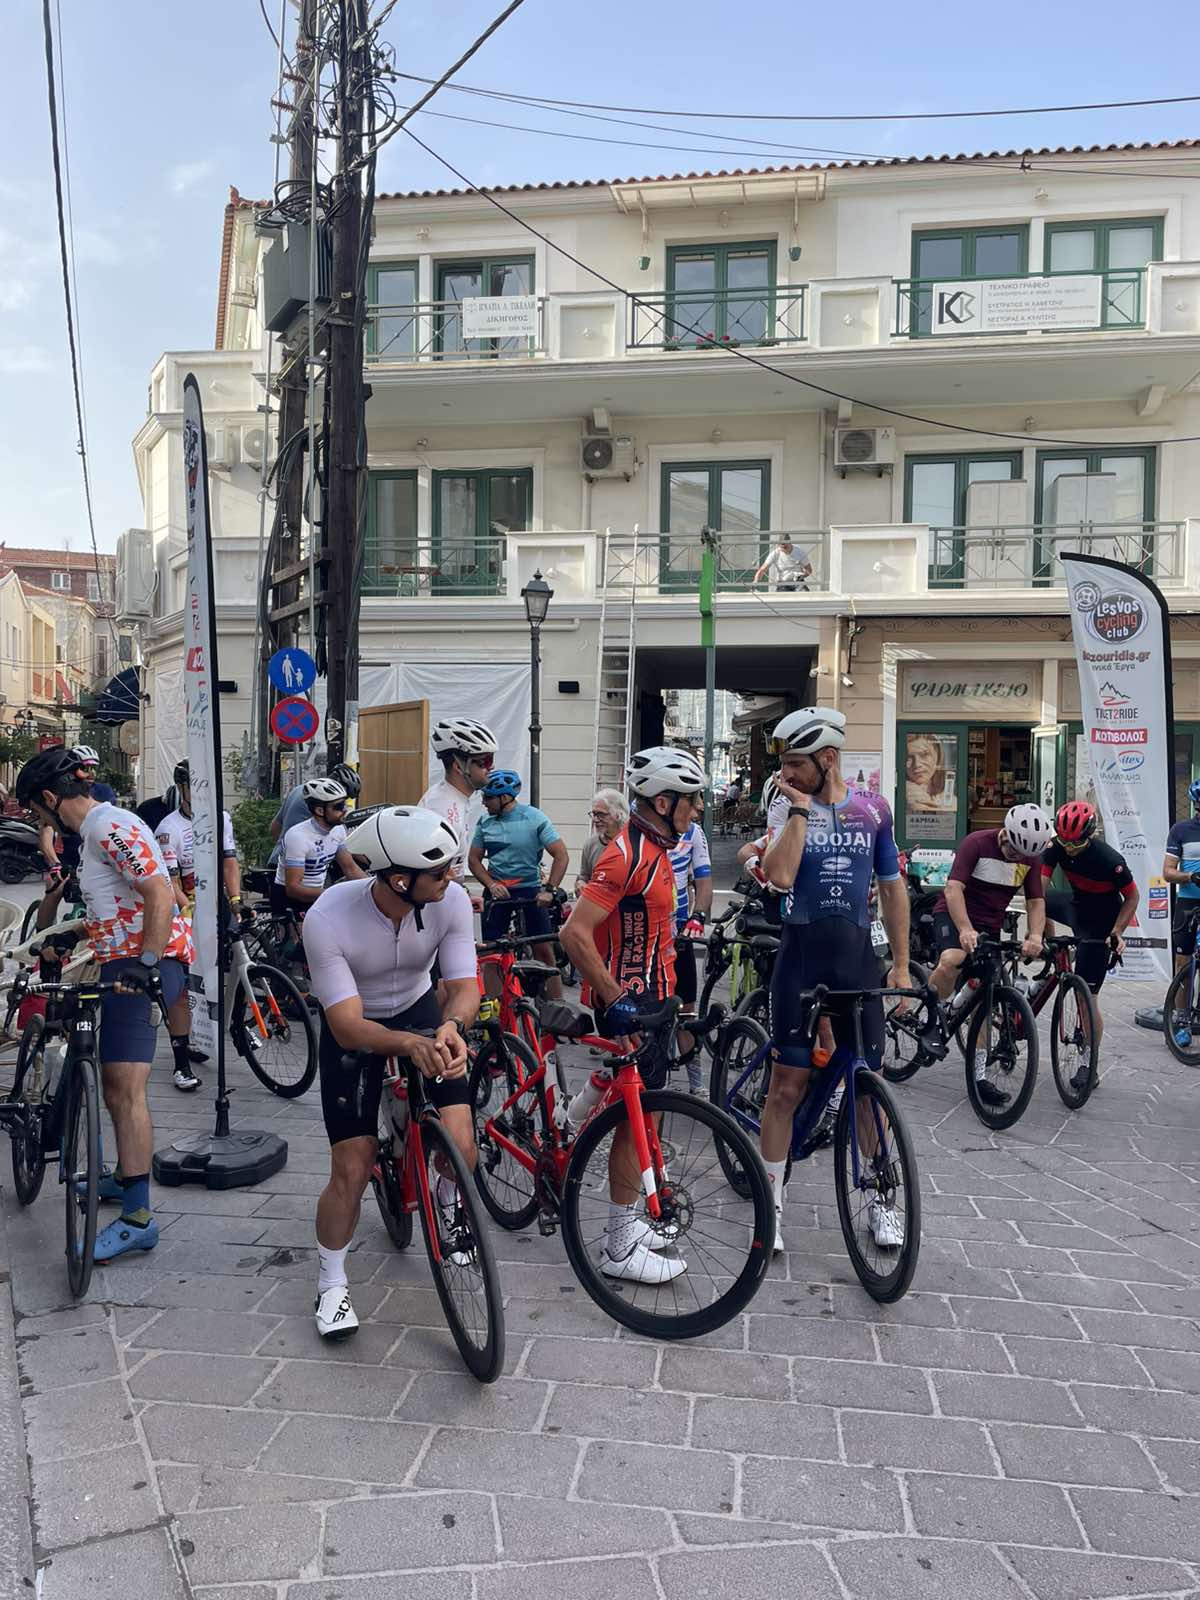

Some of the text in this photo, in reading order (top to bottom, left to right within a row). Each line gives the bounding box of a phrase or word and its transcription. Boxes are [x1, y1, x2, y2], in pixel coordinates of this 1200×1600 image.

[1096, 614, 1137, 630] cycling
[1106, 627, 1129, 639] club
[911, 682, 1028, 698] ΦΑΡΜΑΚΕΙΟ
[805, 846, 870, 857] NSURANCE
[632, 911, 645, 963] RACING
